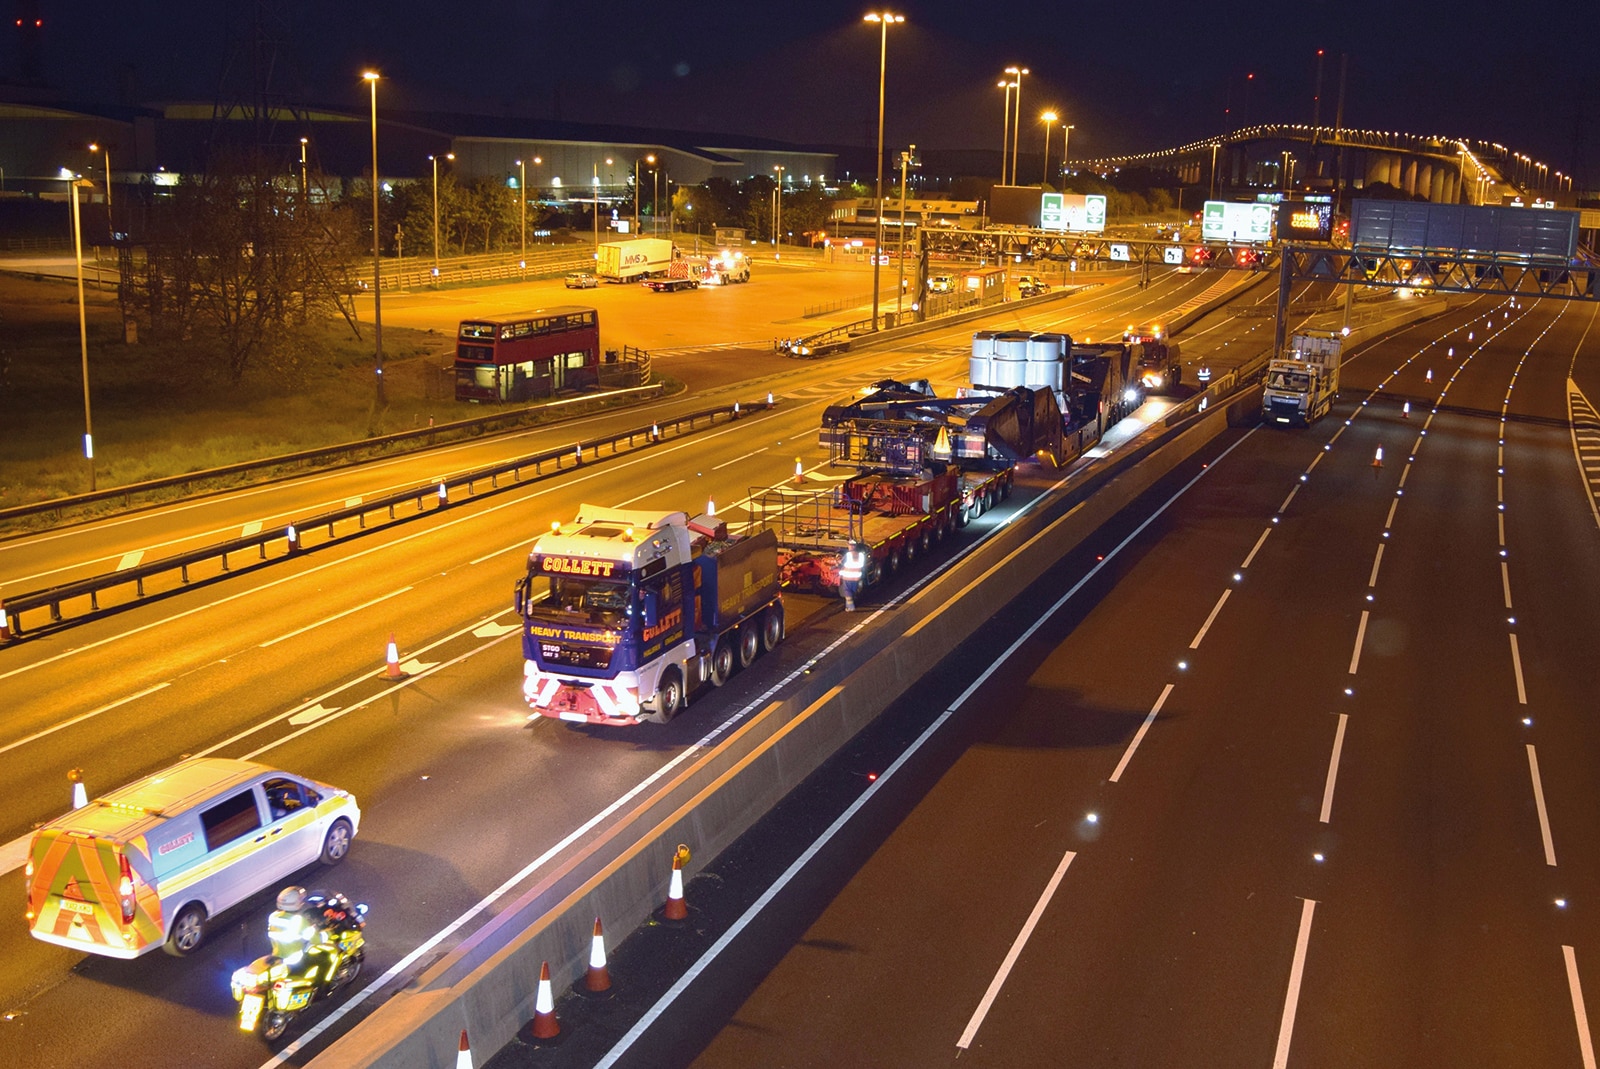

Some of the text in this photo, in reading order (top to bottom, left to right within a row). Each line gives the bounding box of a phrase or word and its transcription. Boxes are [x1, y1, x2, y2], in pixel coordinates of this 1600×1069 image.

[1291, 220, 1319, 228] CLOSED
[983, 238, 992, 246] 30
[1037, 241, 1046, 250] 30
[1081, 244, 1090, 252] 30
[543, 557, 614, 576] COLLETT
[643, 608, 683, 642] COLLETT
[530, 626, 621, 644] HEAVY TRANSPORT
[542, 644, 560, 652] STGO
